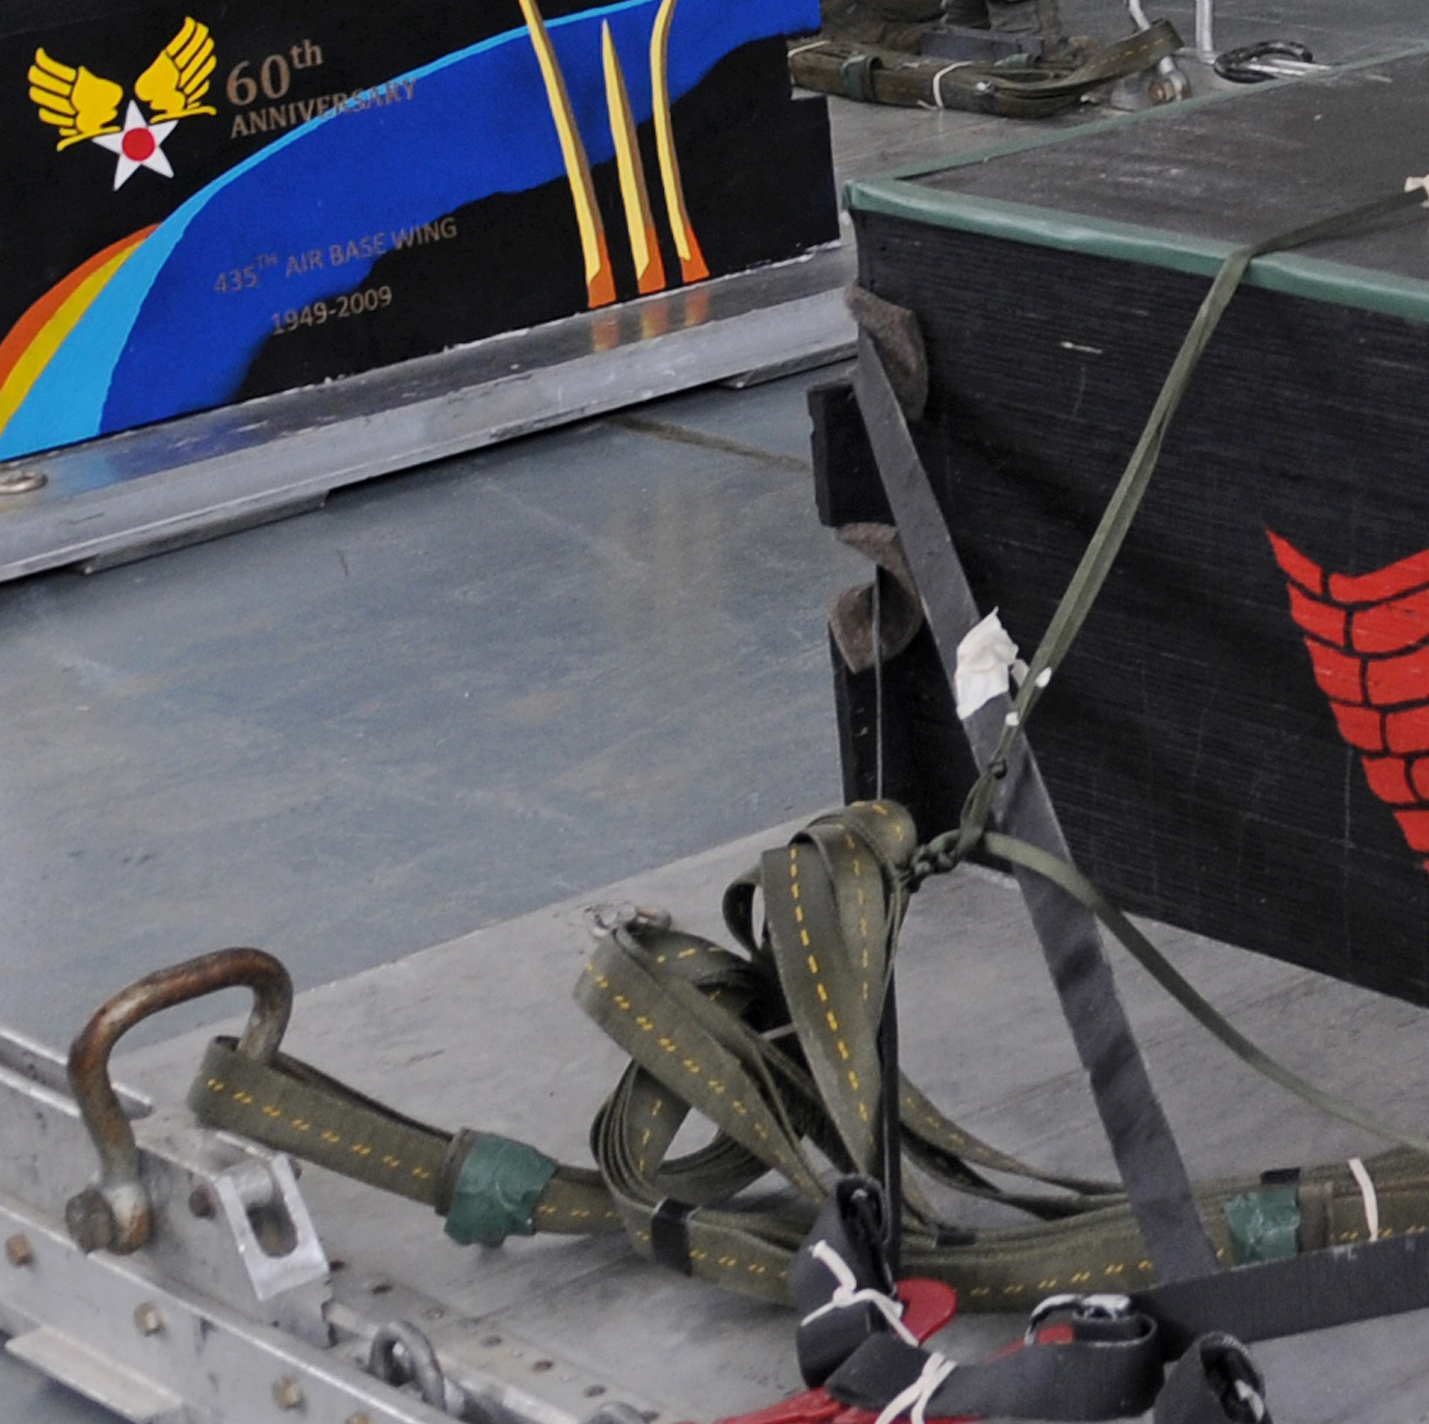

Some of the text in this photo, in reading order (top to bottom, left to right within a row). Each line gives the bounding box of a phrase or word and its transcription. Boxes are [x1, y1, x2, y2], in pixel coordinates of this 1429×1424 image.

[226, 39, 323, 107] 60th
[230, 76, 419, 139] ANNIVERSARY
[285, 248, 325, 278] AIR
[330, 232, 387, 268] BASE
[391, 216, 458, 251] WING
[272, 286, 393, 336] 1949-2009
